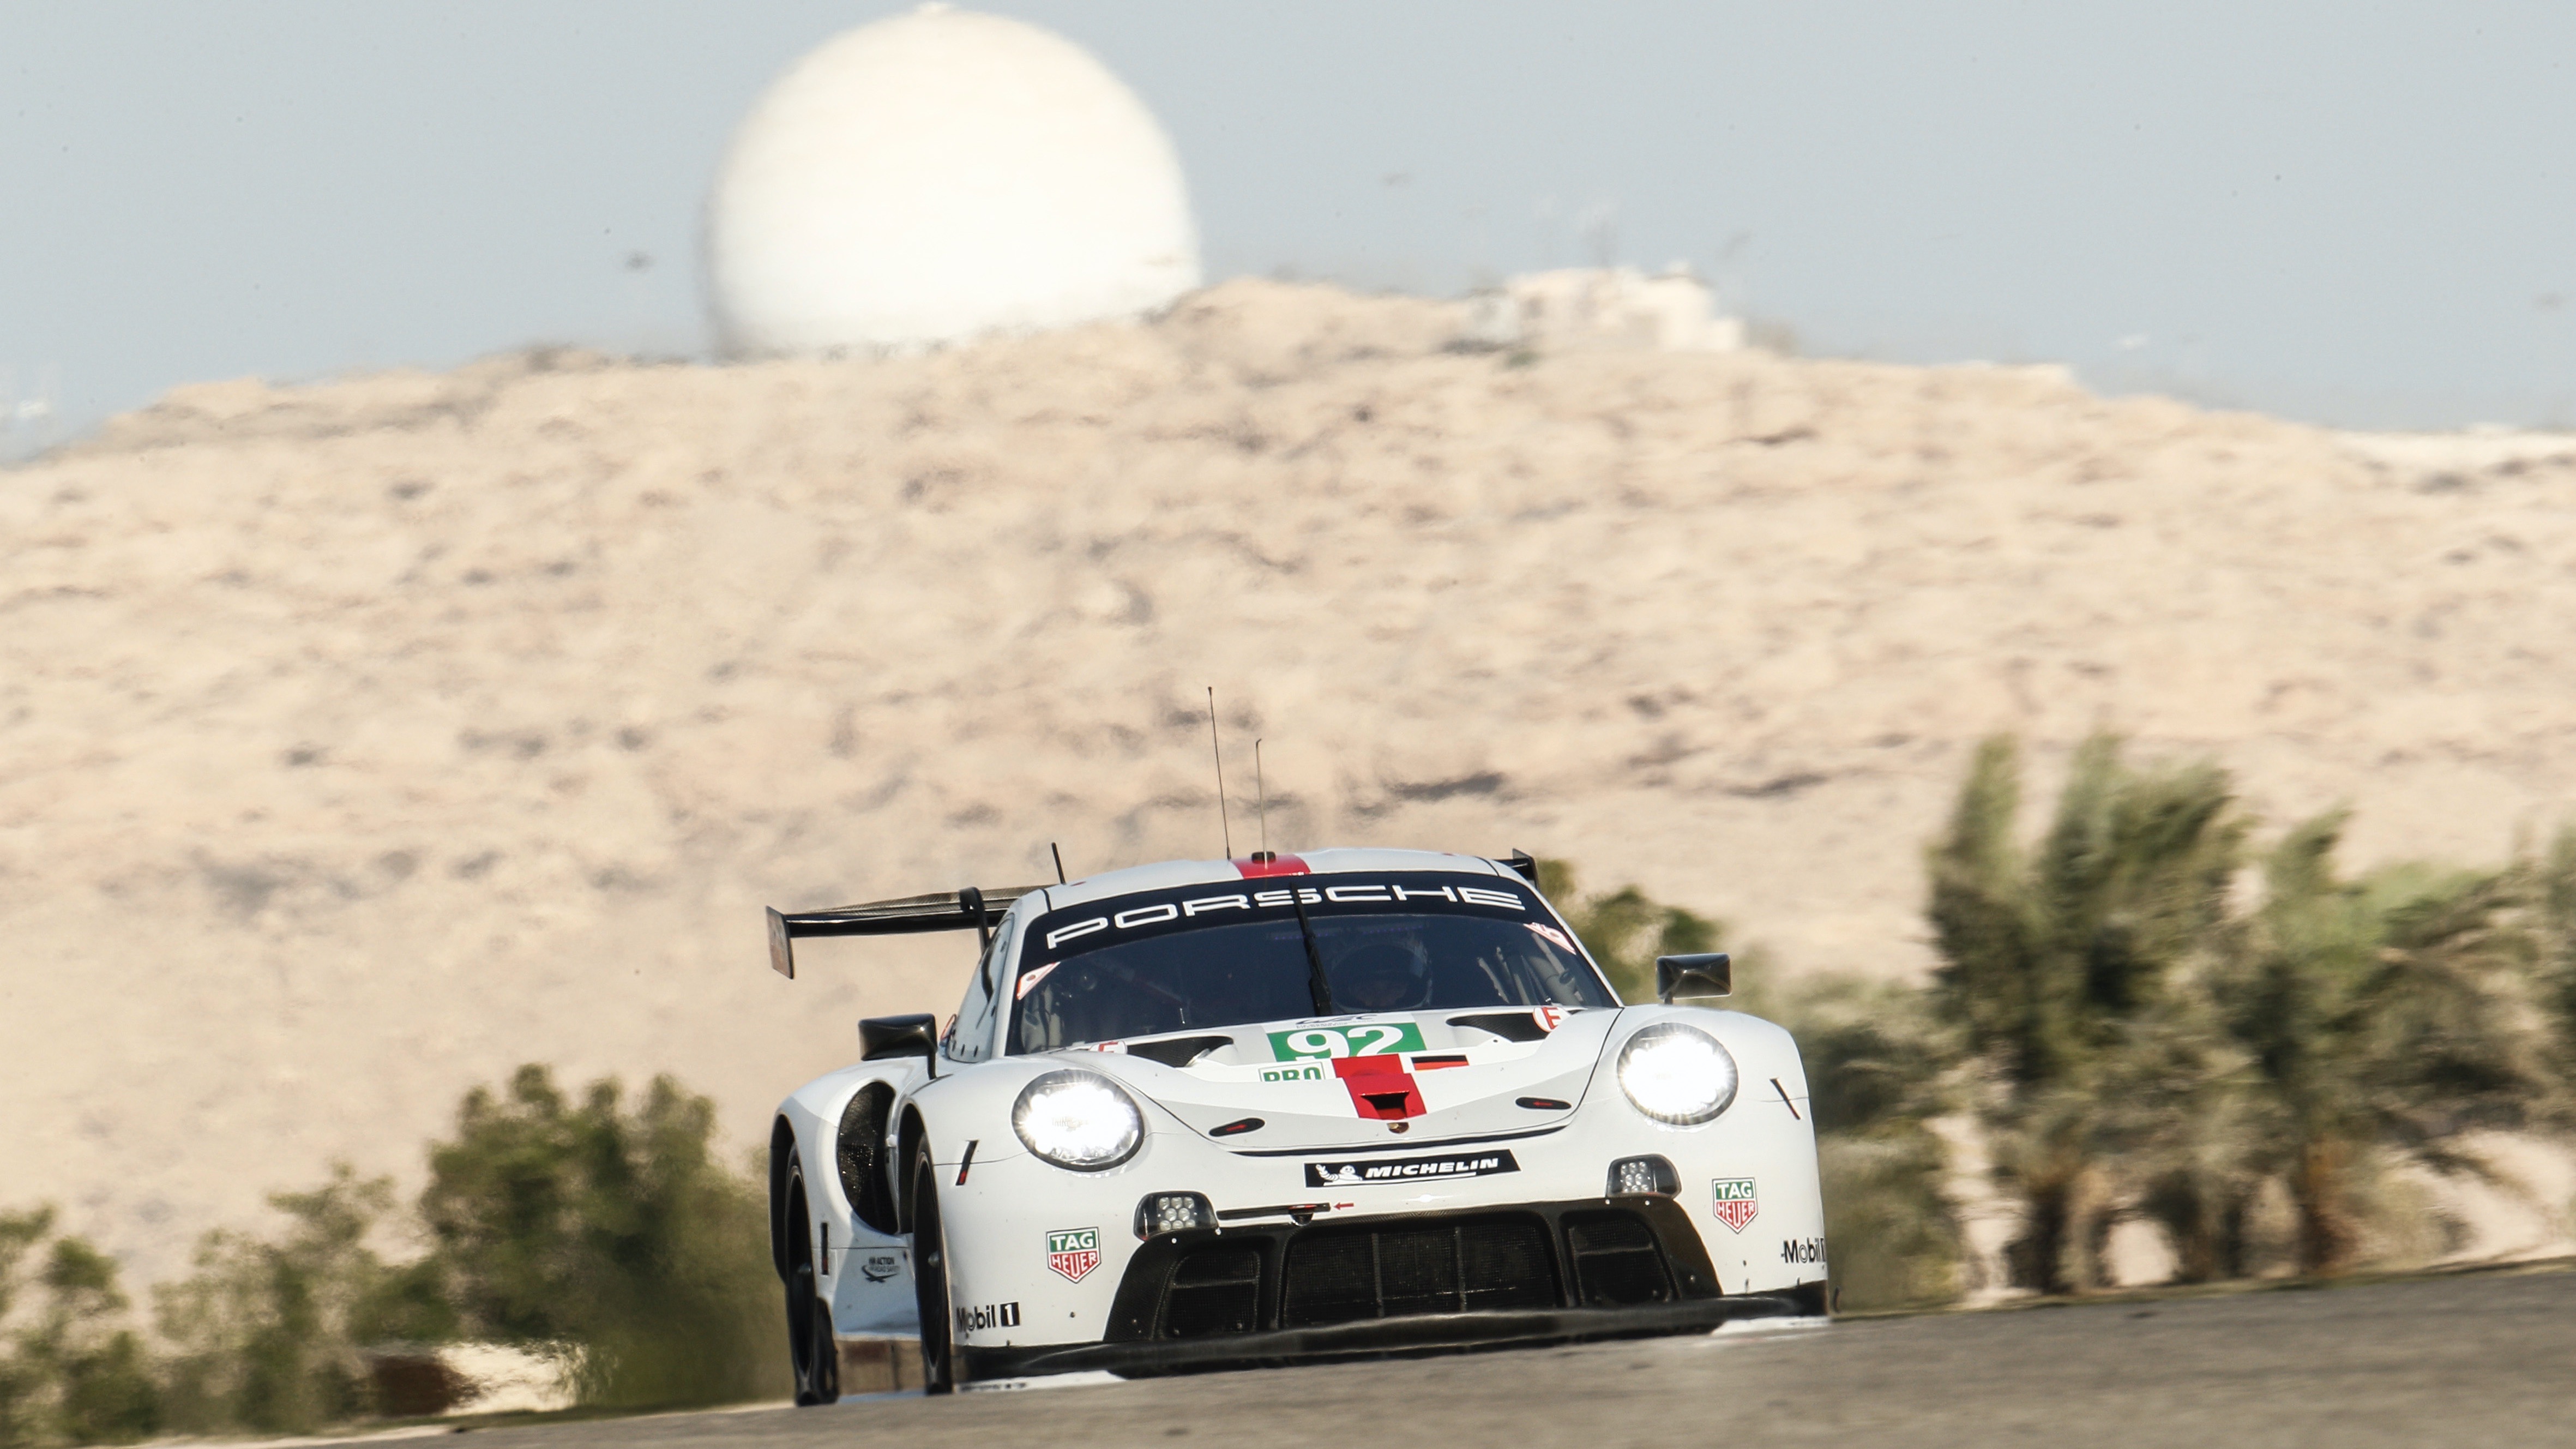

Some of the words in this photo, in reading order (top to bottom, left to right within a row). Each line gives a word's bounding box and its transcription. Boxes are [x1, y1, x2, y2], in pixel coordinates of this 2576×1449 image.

[1046, 885, 1526, 949] PORSCHE
[1541, 1006, 1562, 1030] E
[1286, 1026, 1404, 1060] 92
[1365, 1157, 1498, 1179] MICHELIN
[1717, 1182, 1753, 1199] TAG
[1717, 1201, 1755, 1227] HEUER
[1051, 1232, 1094, 1251] TAG
[1051, 1252, 1097, 1277] HEUER
[956, 1304, 996, 1332] Mobil
